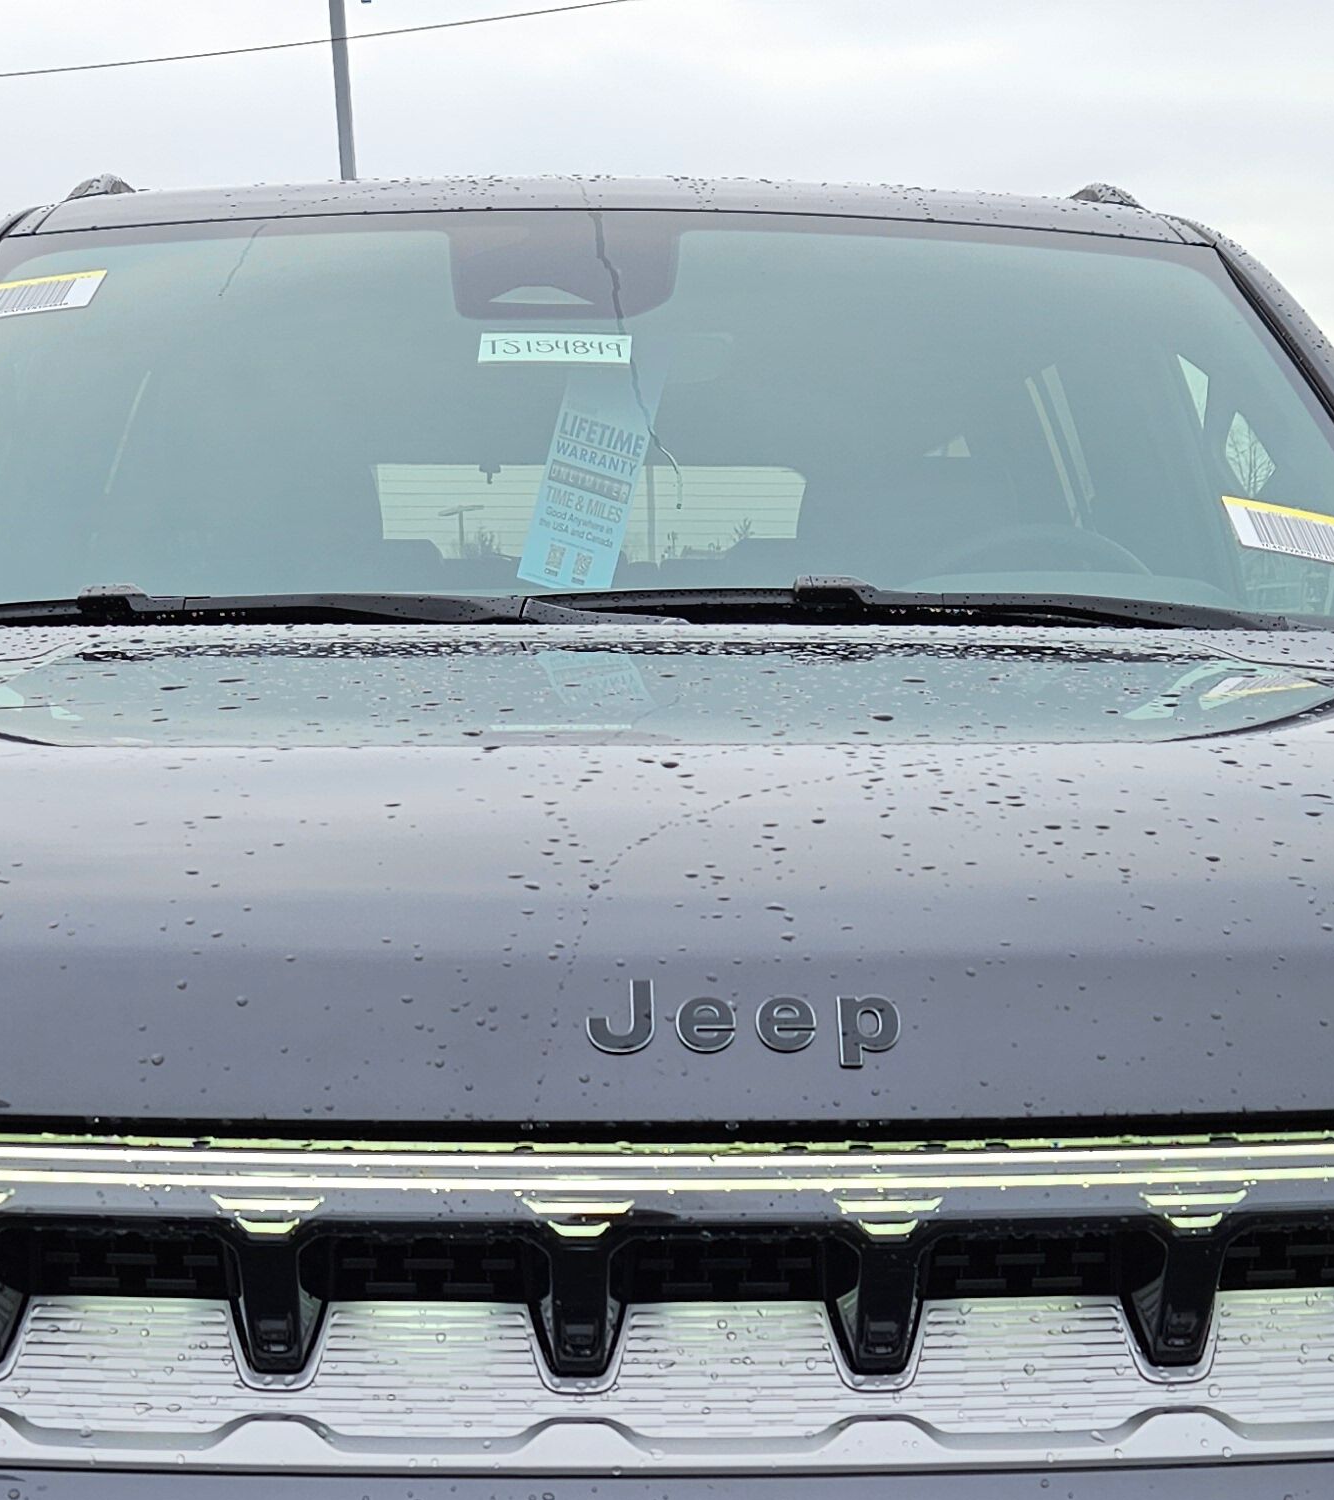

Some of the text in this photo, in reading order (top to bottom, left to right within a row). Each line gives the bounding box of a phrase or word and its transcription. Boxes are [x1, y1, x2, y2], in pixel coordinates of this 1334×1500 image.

[559, 411, 646, 458] LIFETIME
[556, 439, 637, 477] WARRANTY
[546, 485, 575, 509] TIME
[586, 499, 623, 524] MILES
[585, 978, 902, 1070] Jeep
